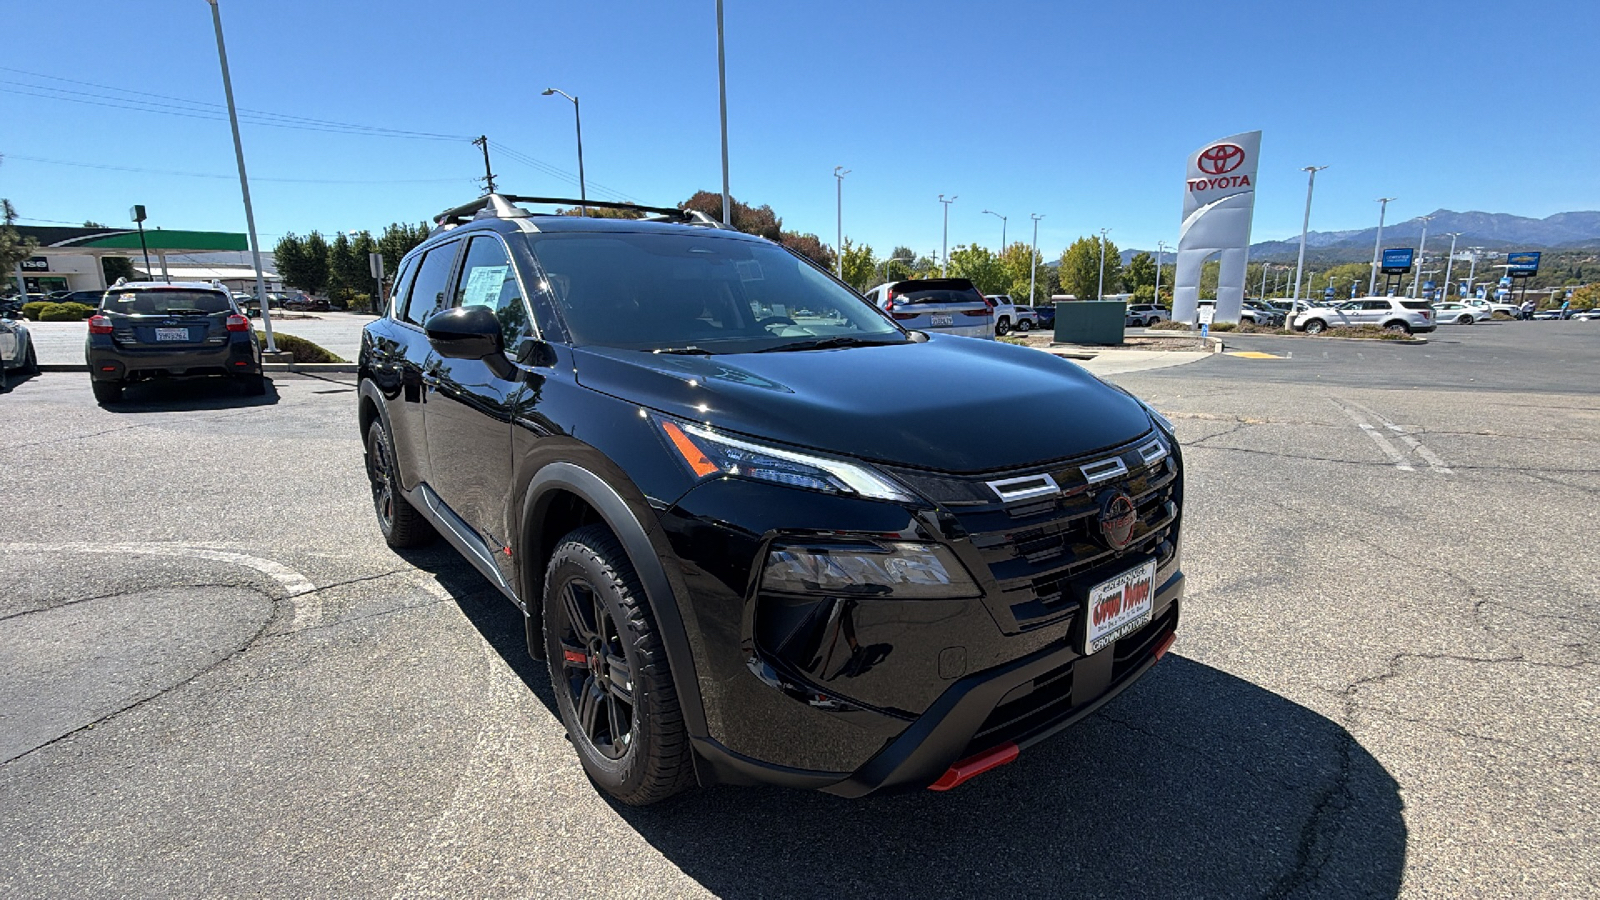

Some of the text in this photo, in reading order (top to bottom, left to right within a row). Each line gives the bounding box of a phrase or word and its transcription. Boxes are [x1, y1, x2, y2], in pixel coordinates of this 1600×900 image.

[1187, 175, 1250, 192] TOYOTA
[1093, 630, 1121, 651] CROWN
[1121, 612, 1150, 637] MOTORS
